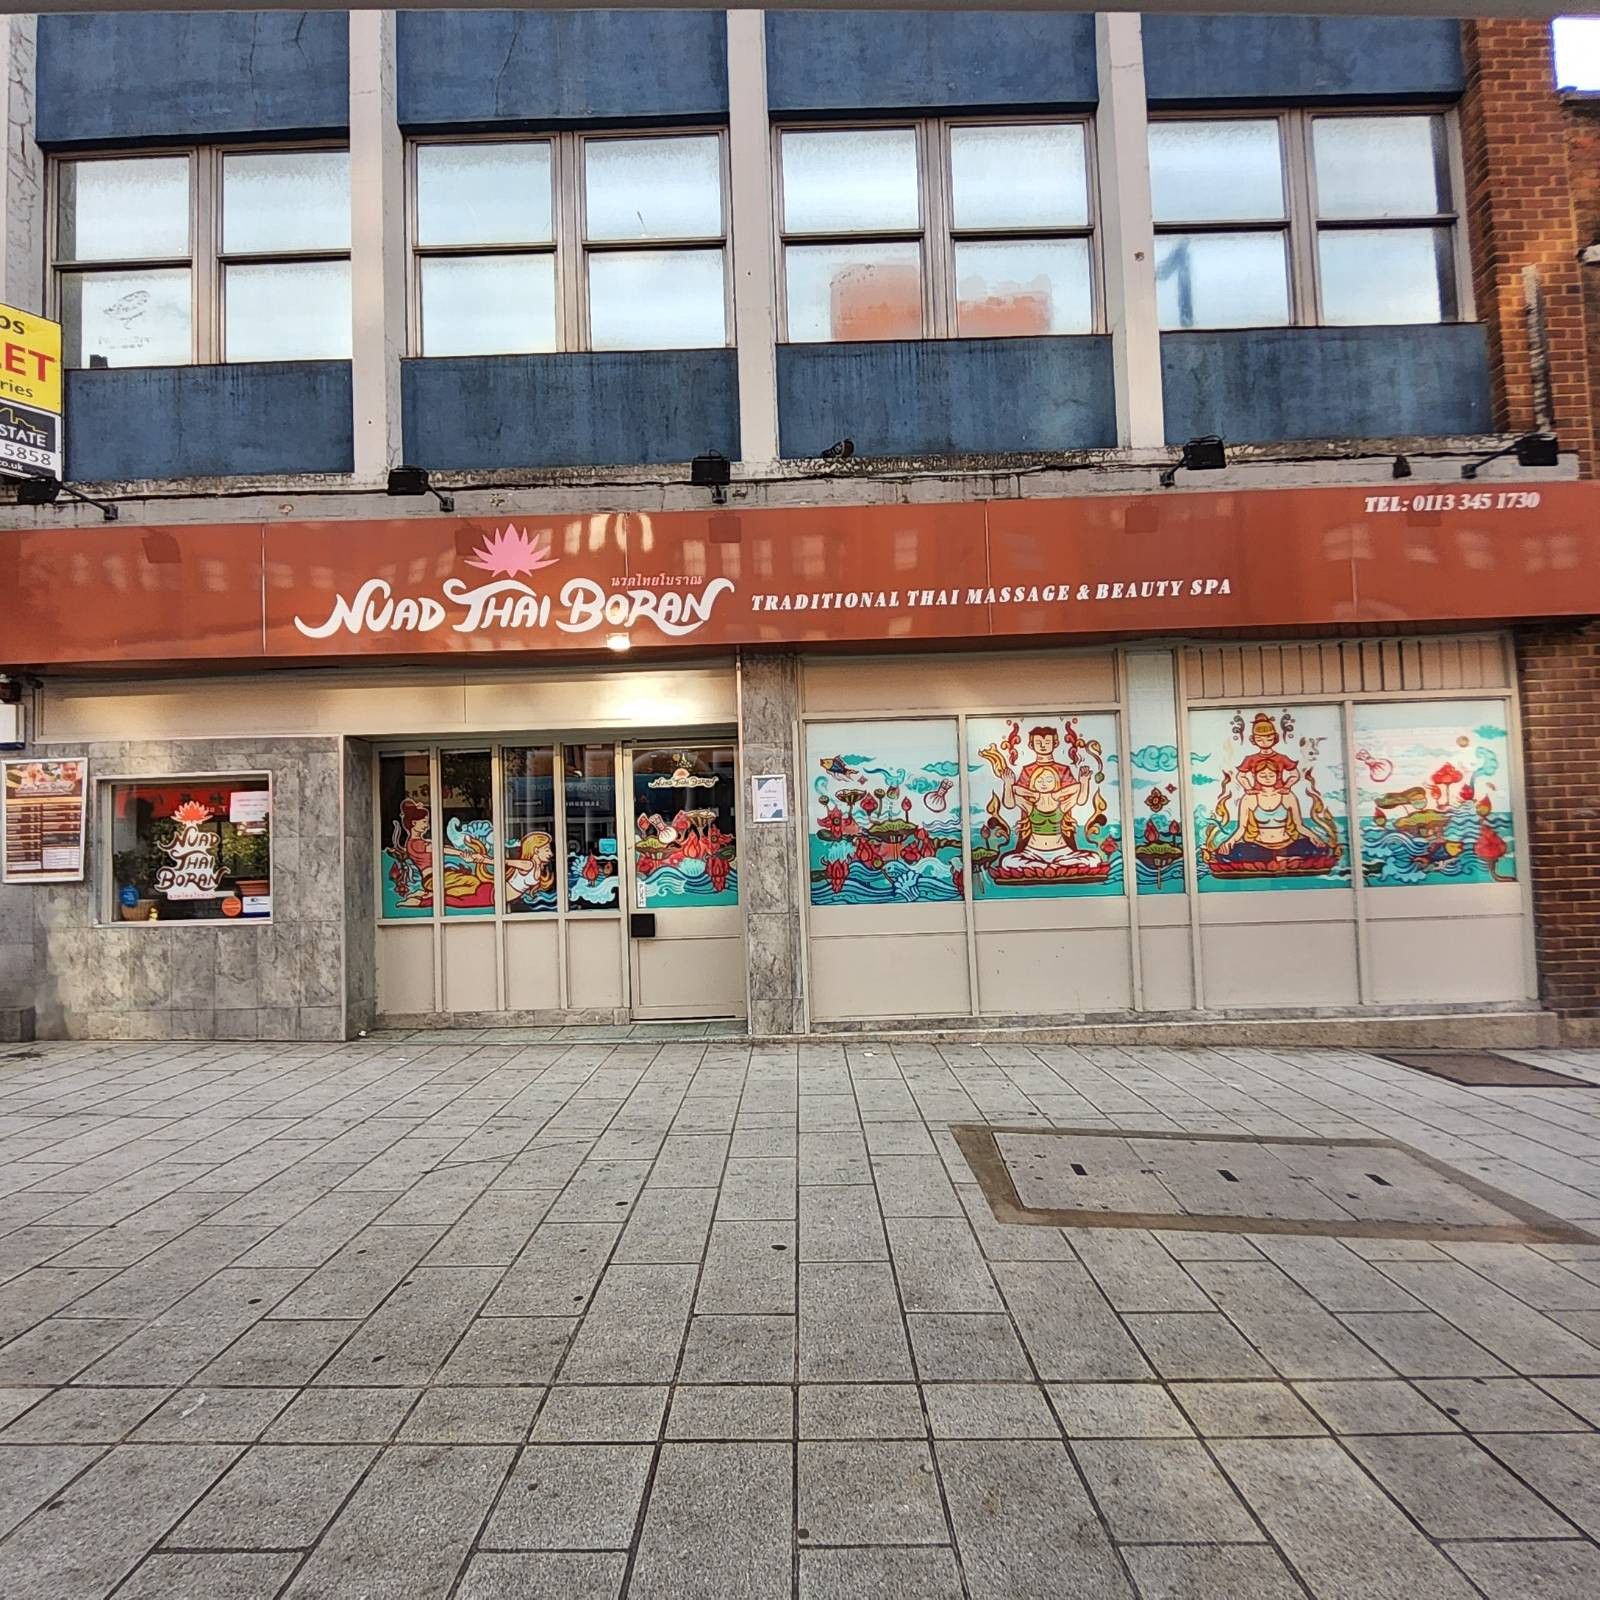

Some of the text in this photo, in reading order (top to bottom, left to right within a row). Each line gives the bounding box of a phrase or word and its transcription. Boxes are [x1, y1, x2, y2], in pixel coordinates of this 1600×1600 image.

[0, 342, 56, 382] ET
[4, 444, 51, 466] 5858
[1365, 492, 1541, 512] TEL: 0113 345 1730
[751, 578, 1231, 611] TRADITIONAL THAI MASSAGE & BEAUTY SPA
[294, 577, 735, 638] NUAD THAI BORAN
[157, 825, 220, 850] NUAD
[170, 850, 214, 870] THAI
[154, 867, 231, 892] BORAN
